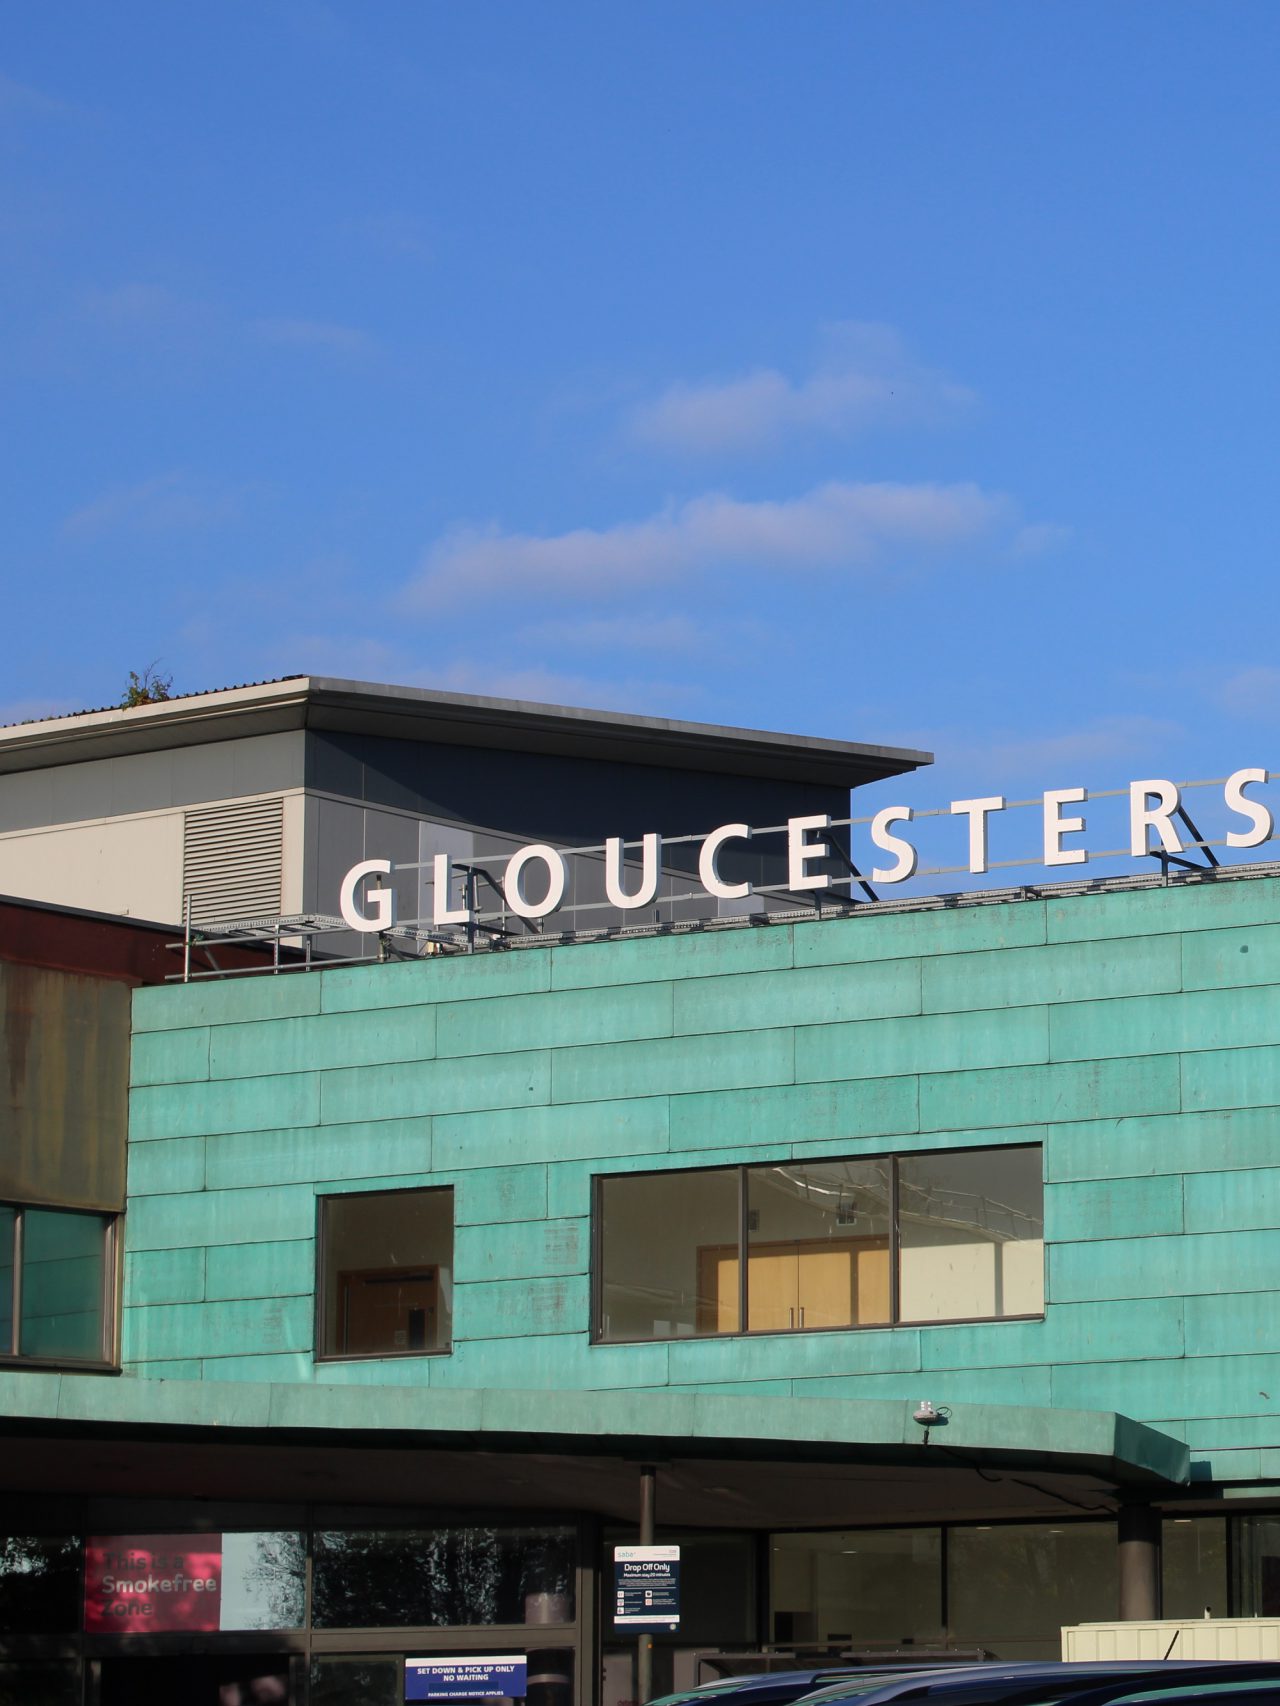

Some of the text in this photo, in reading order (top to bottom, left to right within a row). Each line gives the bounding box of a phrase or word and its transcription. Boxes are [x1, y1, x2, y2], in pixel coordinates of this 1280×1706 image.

[102, 1551, 184, 1570] This is a
[624, 1563, 670, 1573] Drop Off Only
[102, 1574, 217, 1594] Smokefree
[101, 1599, 153, 1617] Zone
[417, 1667, 430, 1675] SET
[458, 1666, 463, 1674] &
[495, 1665, 515, 1673] ONLY
[443, 1673, 489, 1682] NO WAITING
